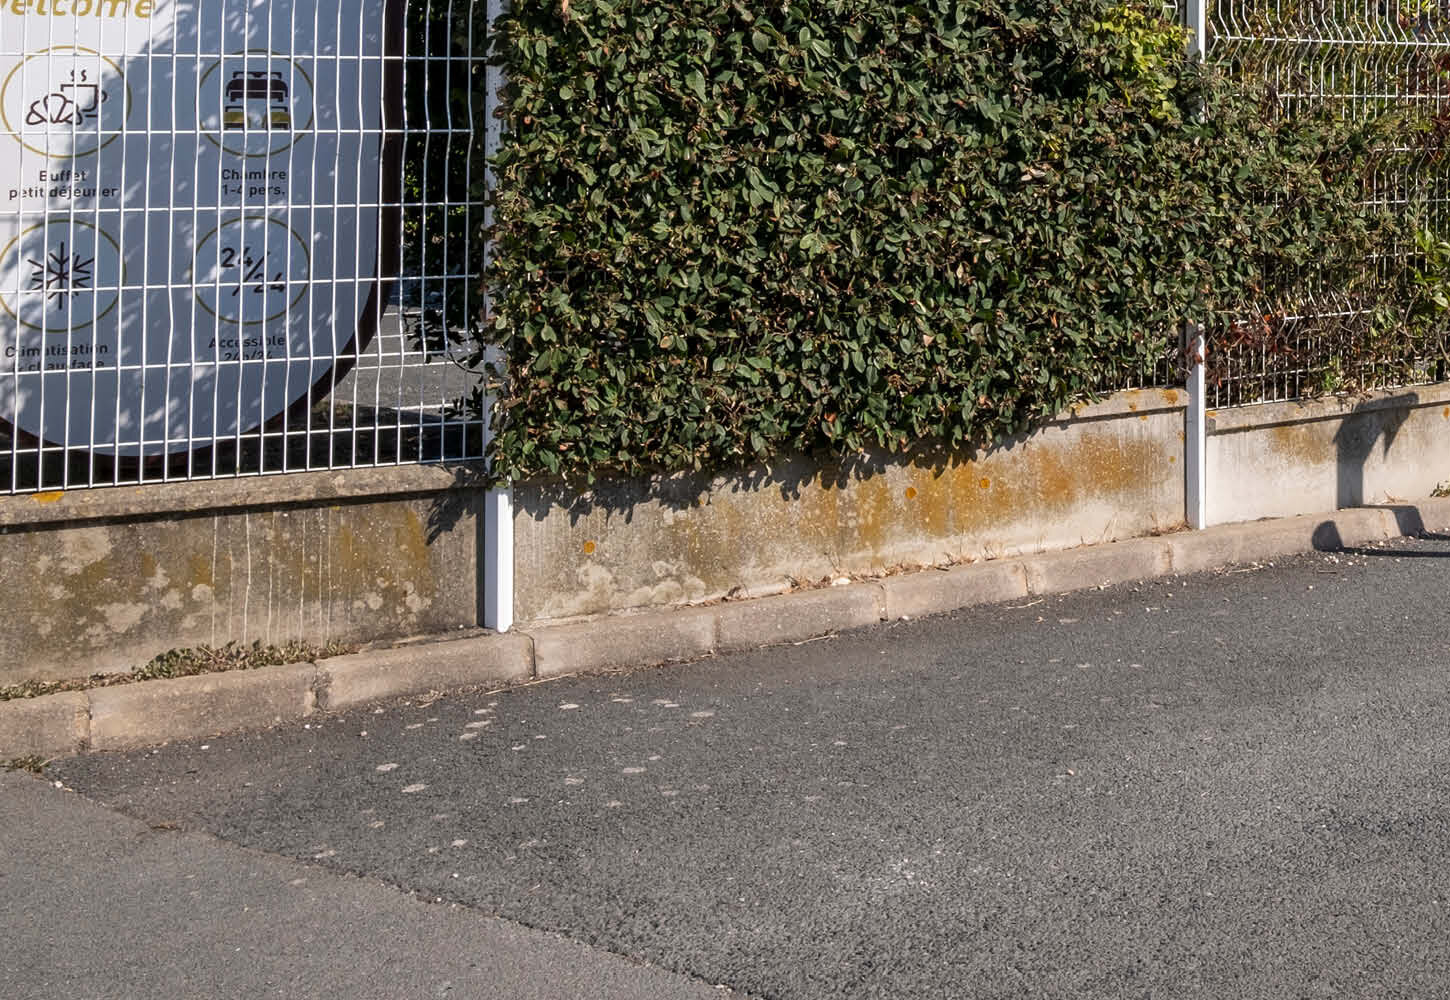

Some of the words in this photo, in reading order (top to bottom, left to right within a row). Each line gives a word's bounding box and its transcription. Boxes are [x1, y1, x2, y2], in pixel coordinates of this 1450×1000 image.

[39, 169, 87, 182] Buffet
[9, 187, 44, 200] petit
[5, 343, 108, 358] Cimtisation
